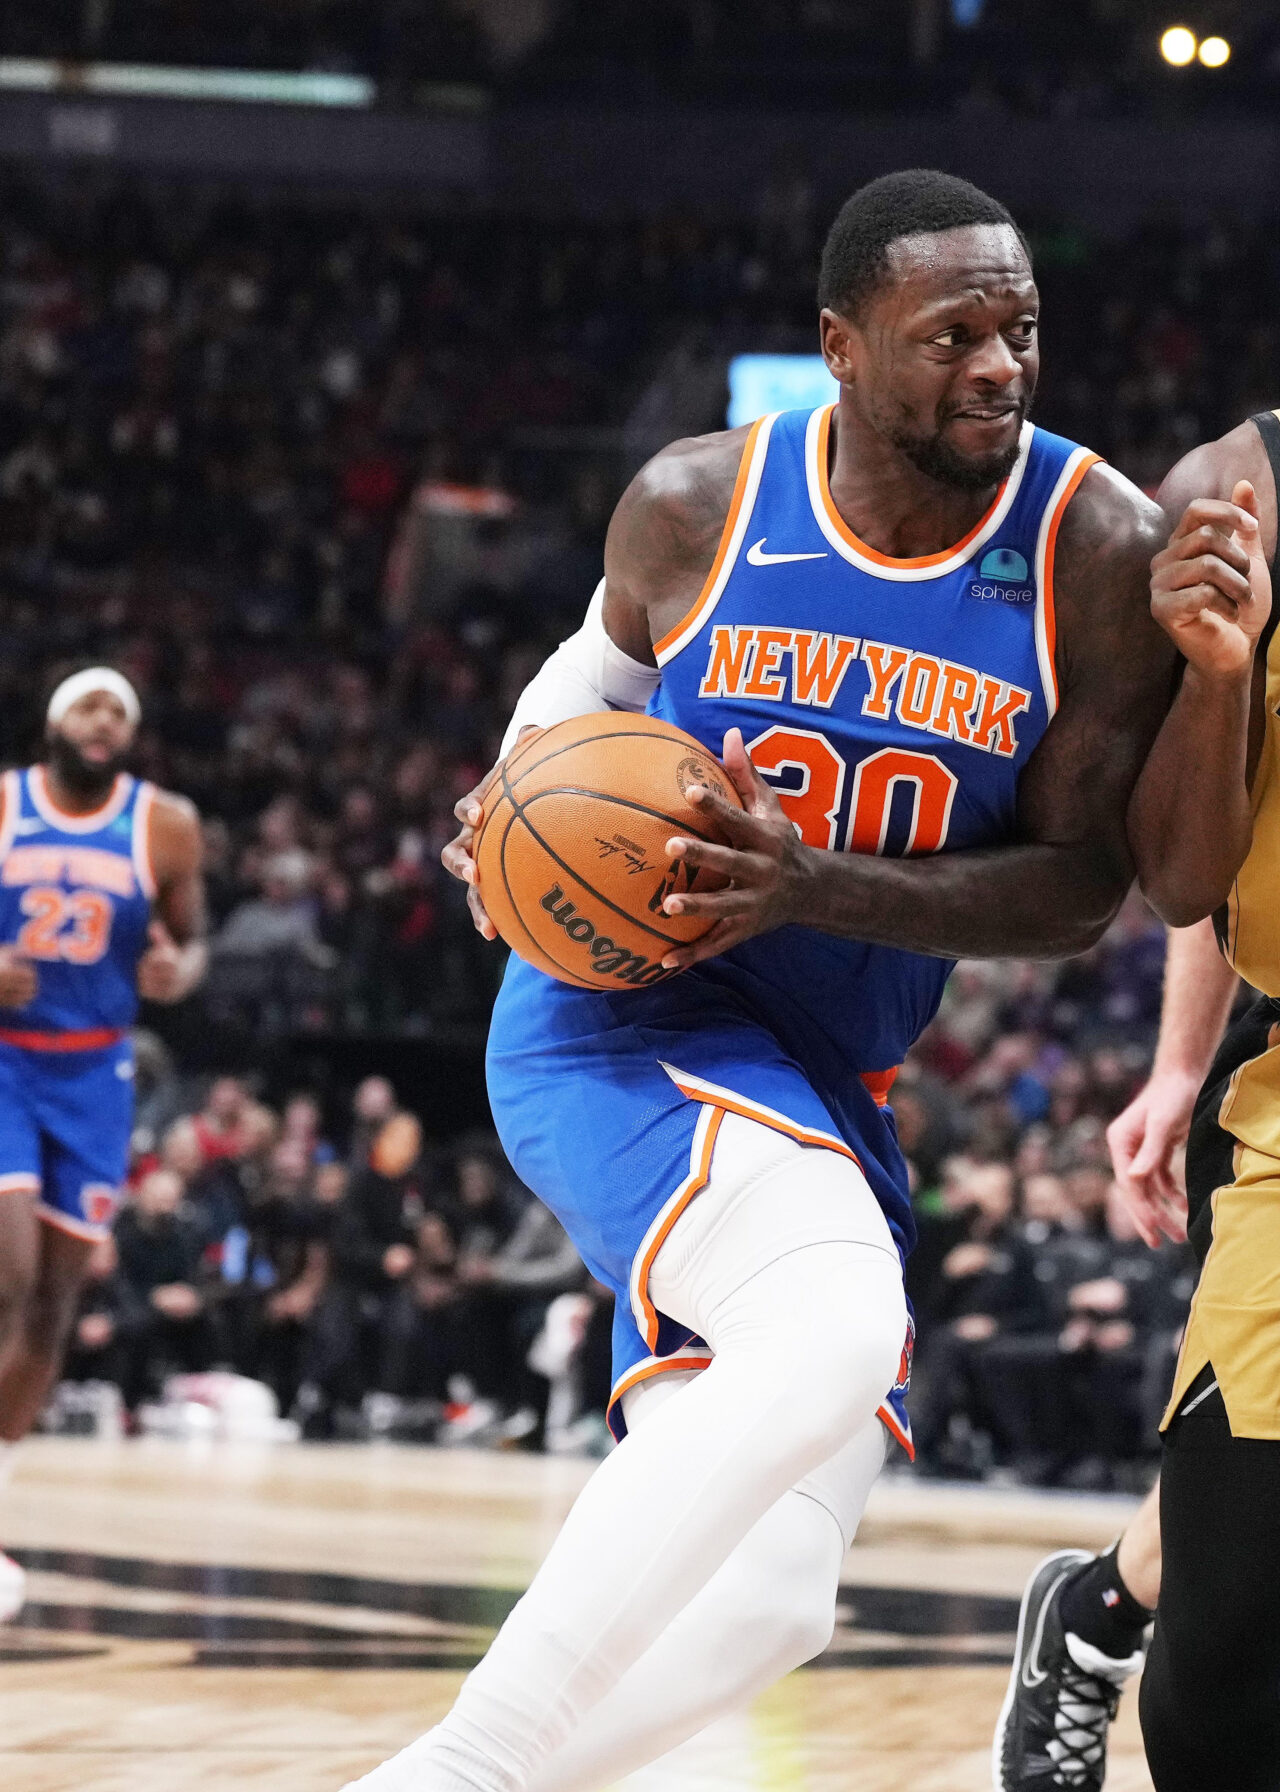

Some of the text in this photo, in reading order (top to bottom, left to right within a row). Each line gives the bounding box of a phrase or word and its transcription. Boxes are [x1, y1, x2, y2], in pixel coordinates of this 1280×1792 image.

[970, 584, 1033, 602] sphere
[698, 624, 1032, 759] NEW YORK
[745, 724, 959, 858] 30
[18, 886, 114, 965] 23
